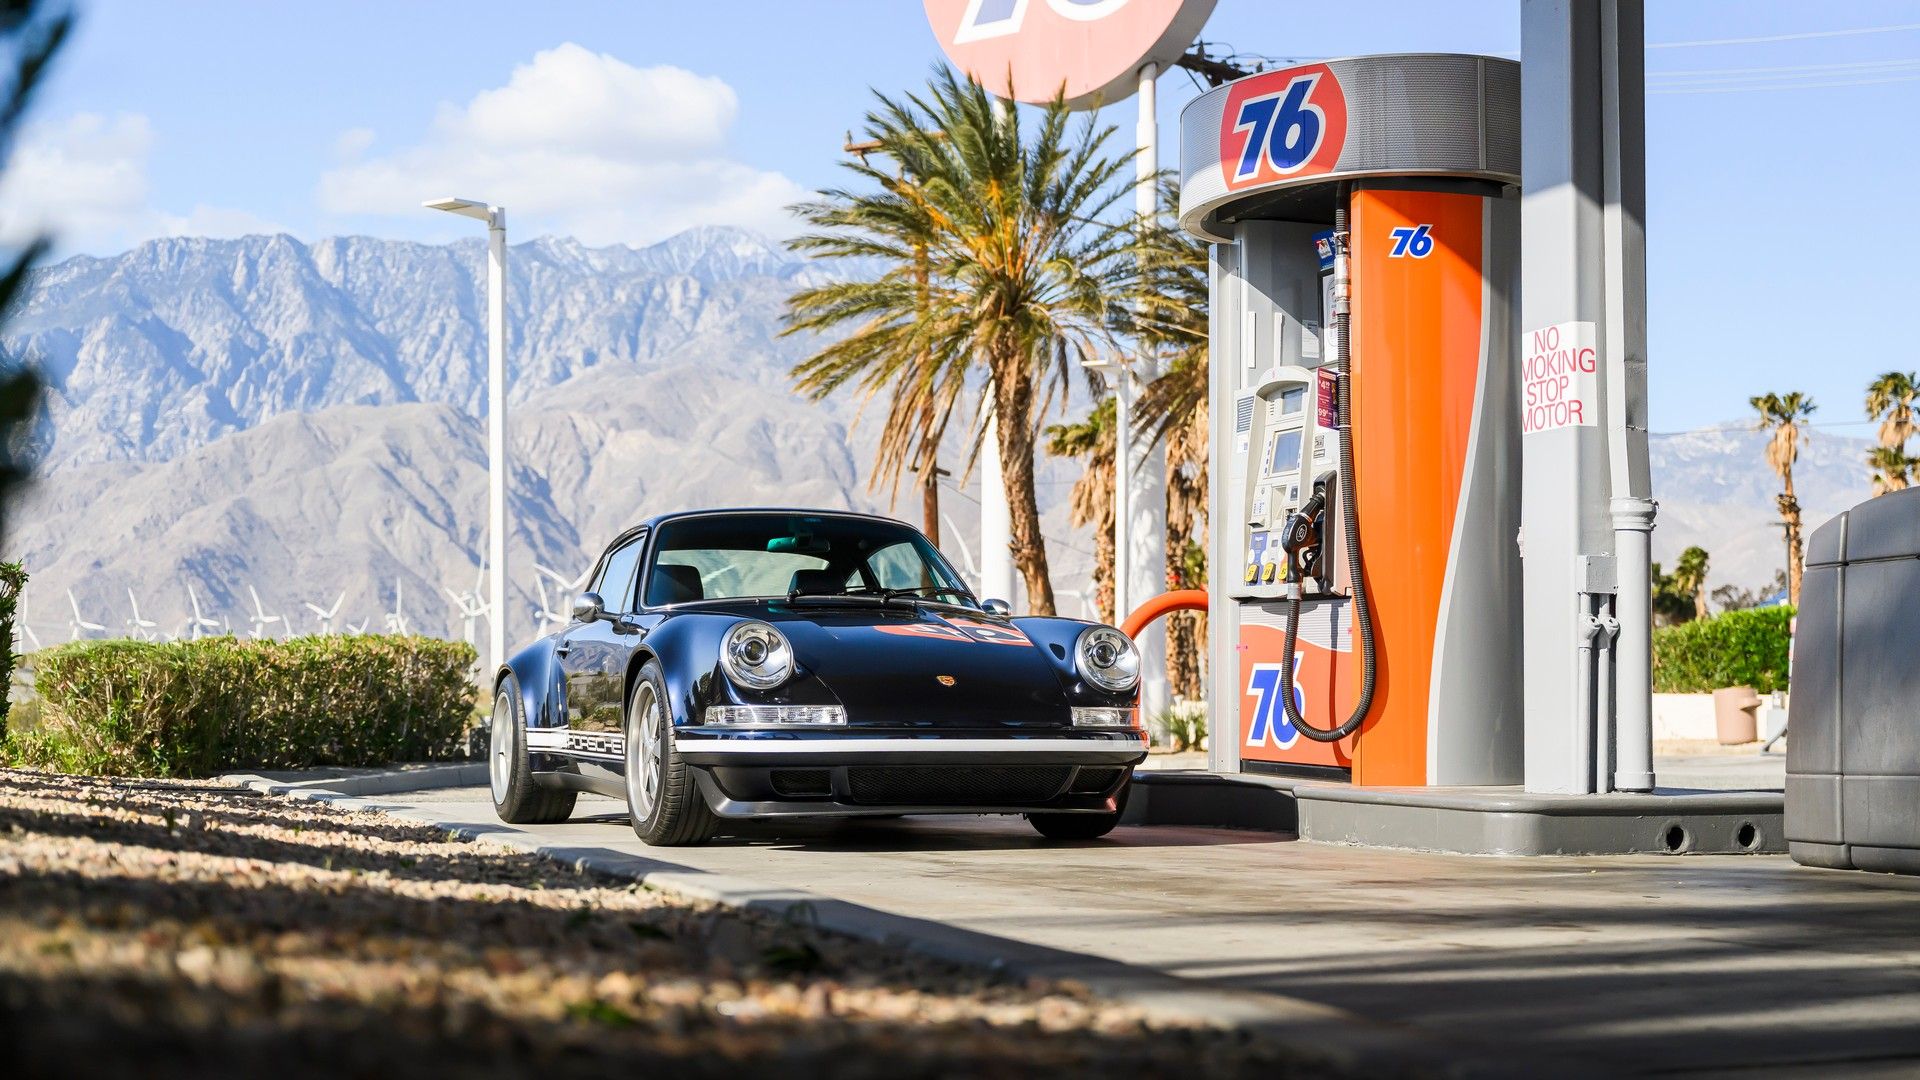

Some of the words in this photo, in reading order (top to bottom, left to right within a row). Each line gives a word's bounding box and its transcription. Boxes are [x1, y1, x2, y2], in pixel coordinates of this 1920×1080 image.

[1232, 72, 1326, 183] 76
[1388, 224, 1434, 258] 76
[1534, 326, 1559, 354] NO
[1527, 376, 1569, 406] STOP
[1522, 399, 1583, 432] MOTOR
[1245, 651, 1305, 750] 76
